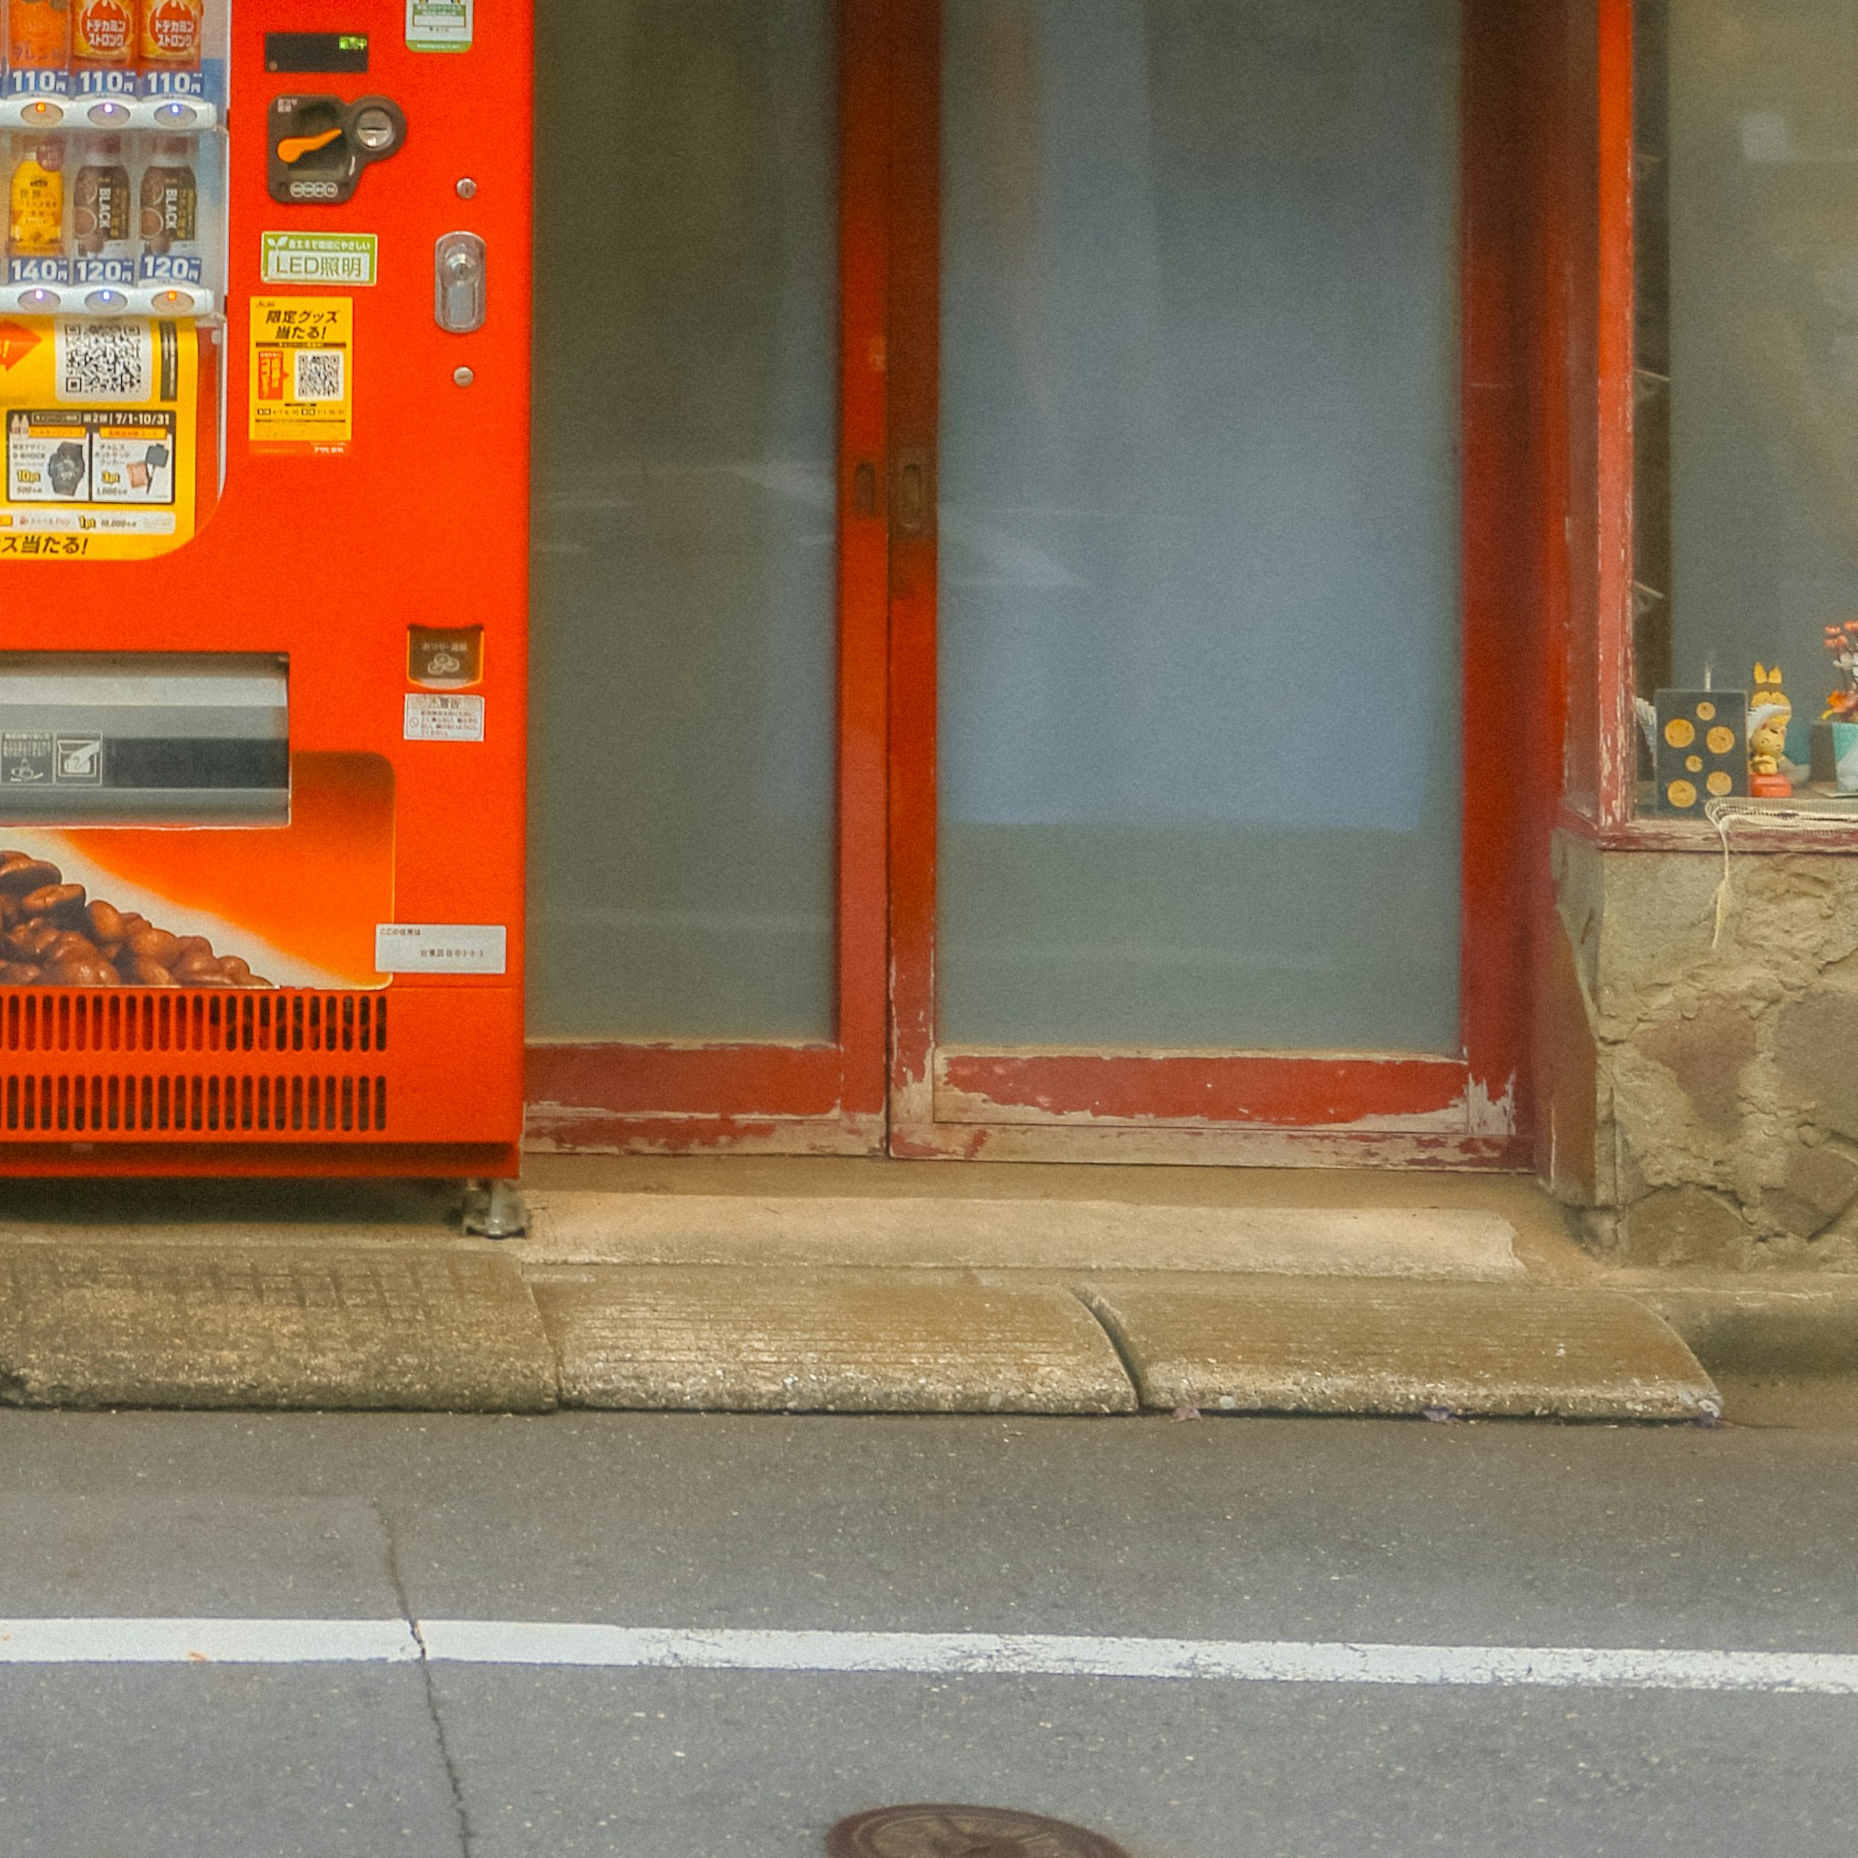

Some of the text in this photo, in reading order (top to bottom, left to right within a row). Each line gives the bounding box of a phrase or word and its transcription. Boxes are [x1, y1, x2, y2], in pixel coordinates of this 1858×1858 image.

[98, 187, 112, 230] BLACK
[165, 188, 178, 230] BLACK
[276, 255, 362, 277] LED照明
[265, 310, 341, 324] 限定グッズ
[275, 325, 327, 340] 当たる!
